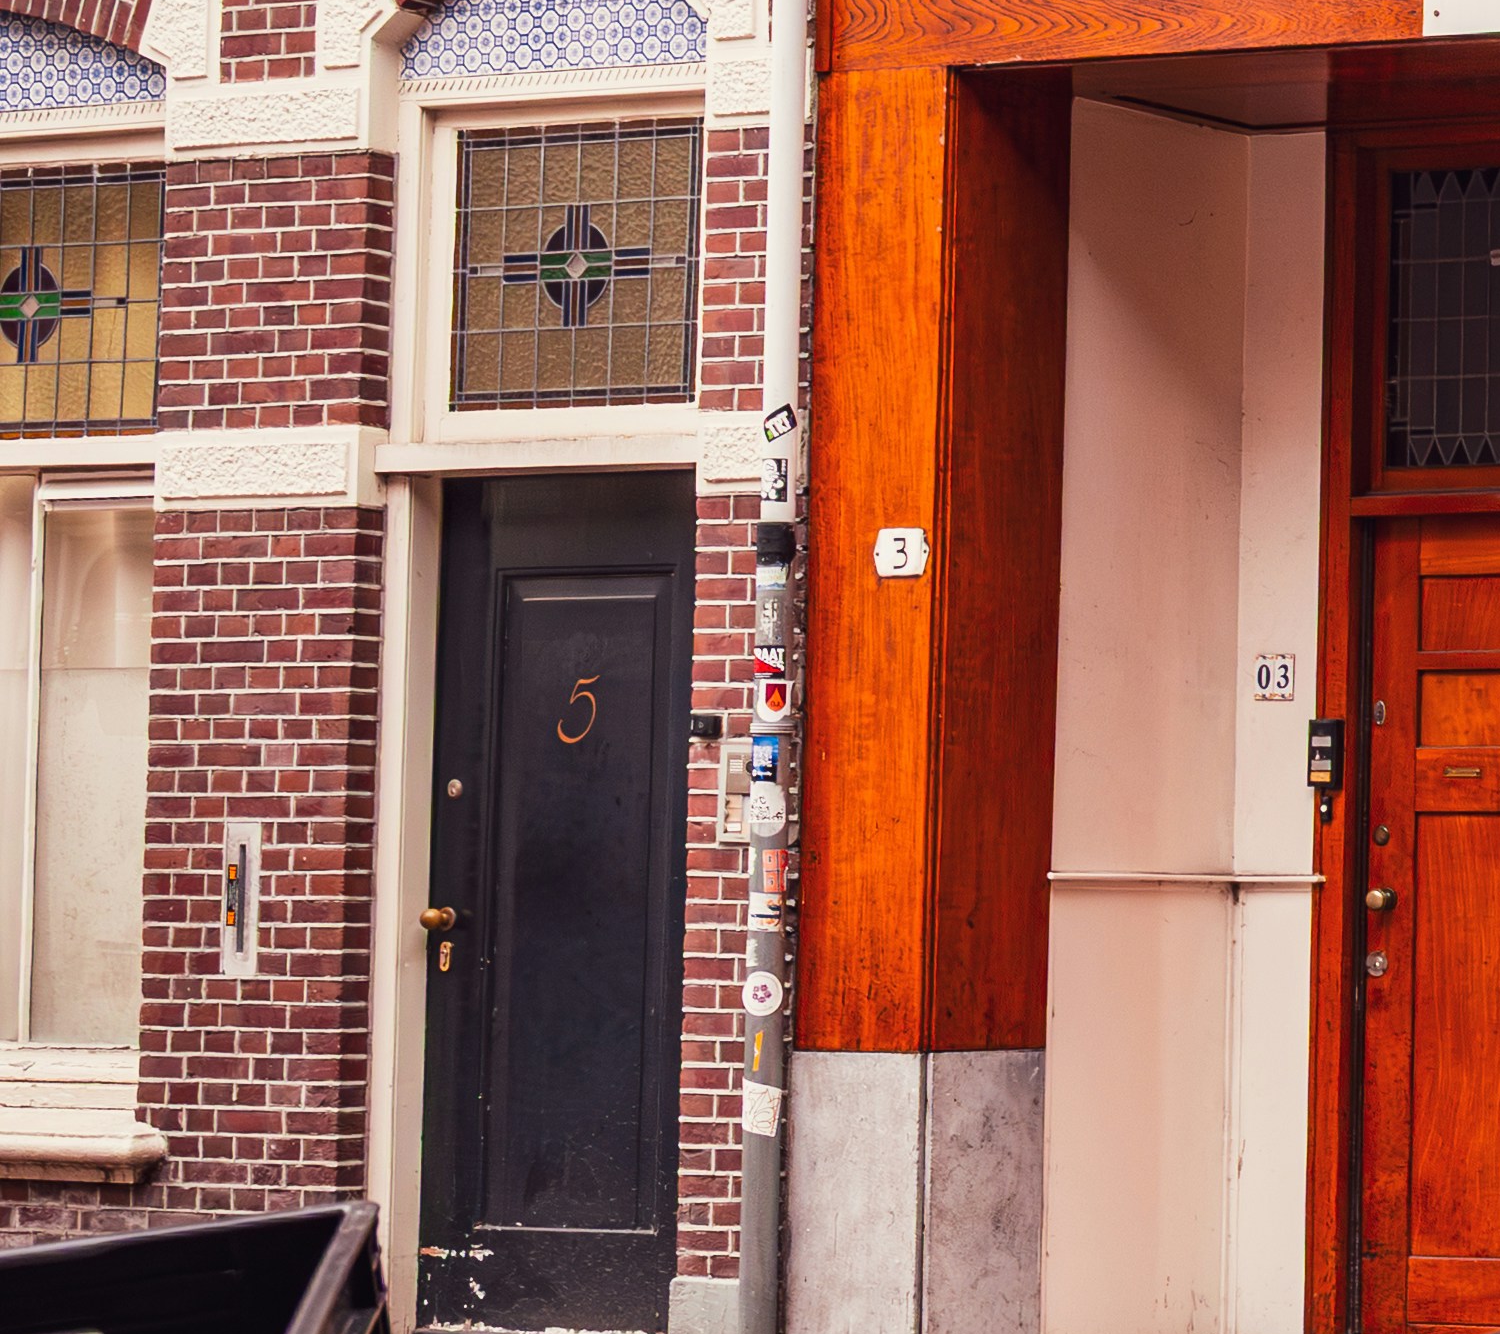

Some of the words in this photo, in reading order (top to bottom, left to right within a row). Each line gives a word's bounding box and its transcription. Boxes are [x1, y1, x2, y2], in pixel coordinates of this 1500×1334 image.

[892, 537, 908, 569] 3
[1257, 664, 1290, 690] 03
[557, 674, 600, 744] 5
